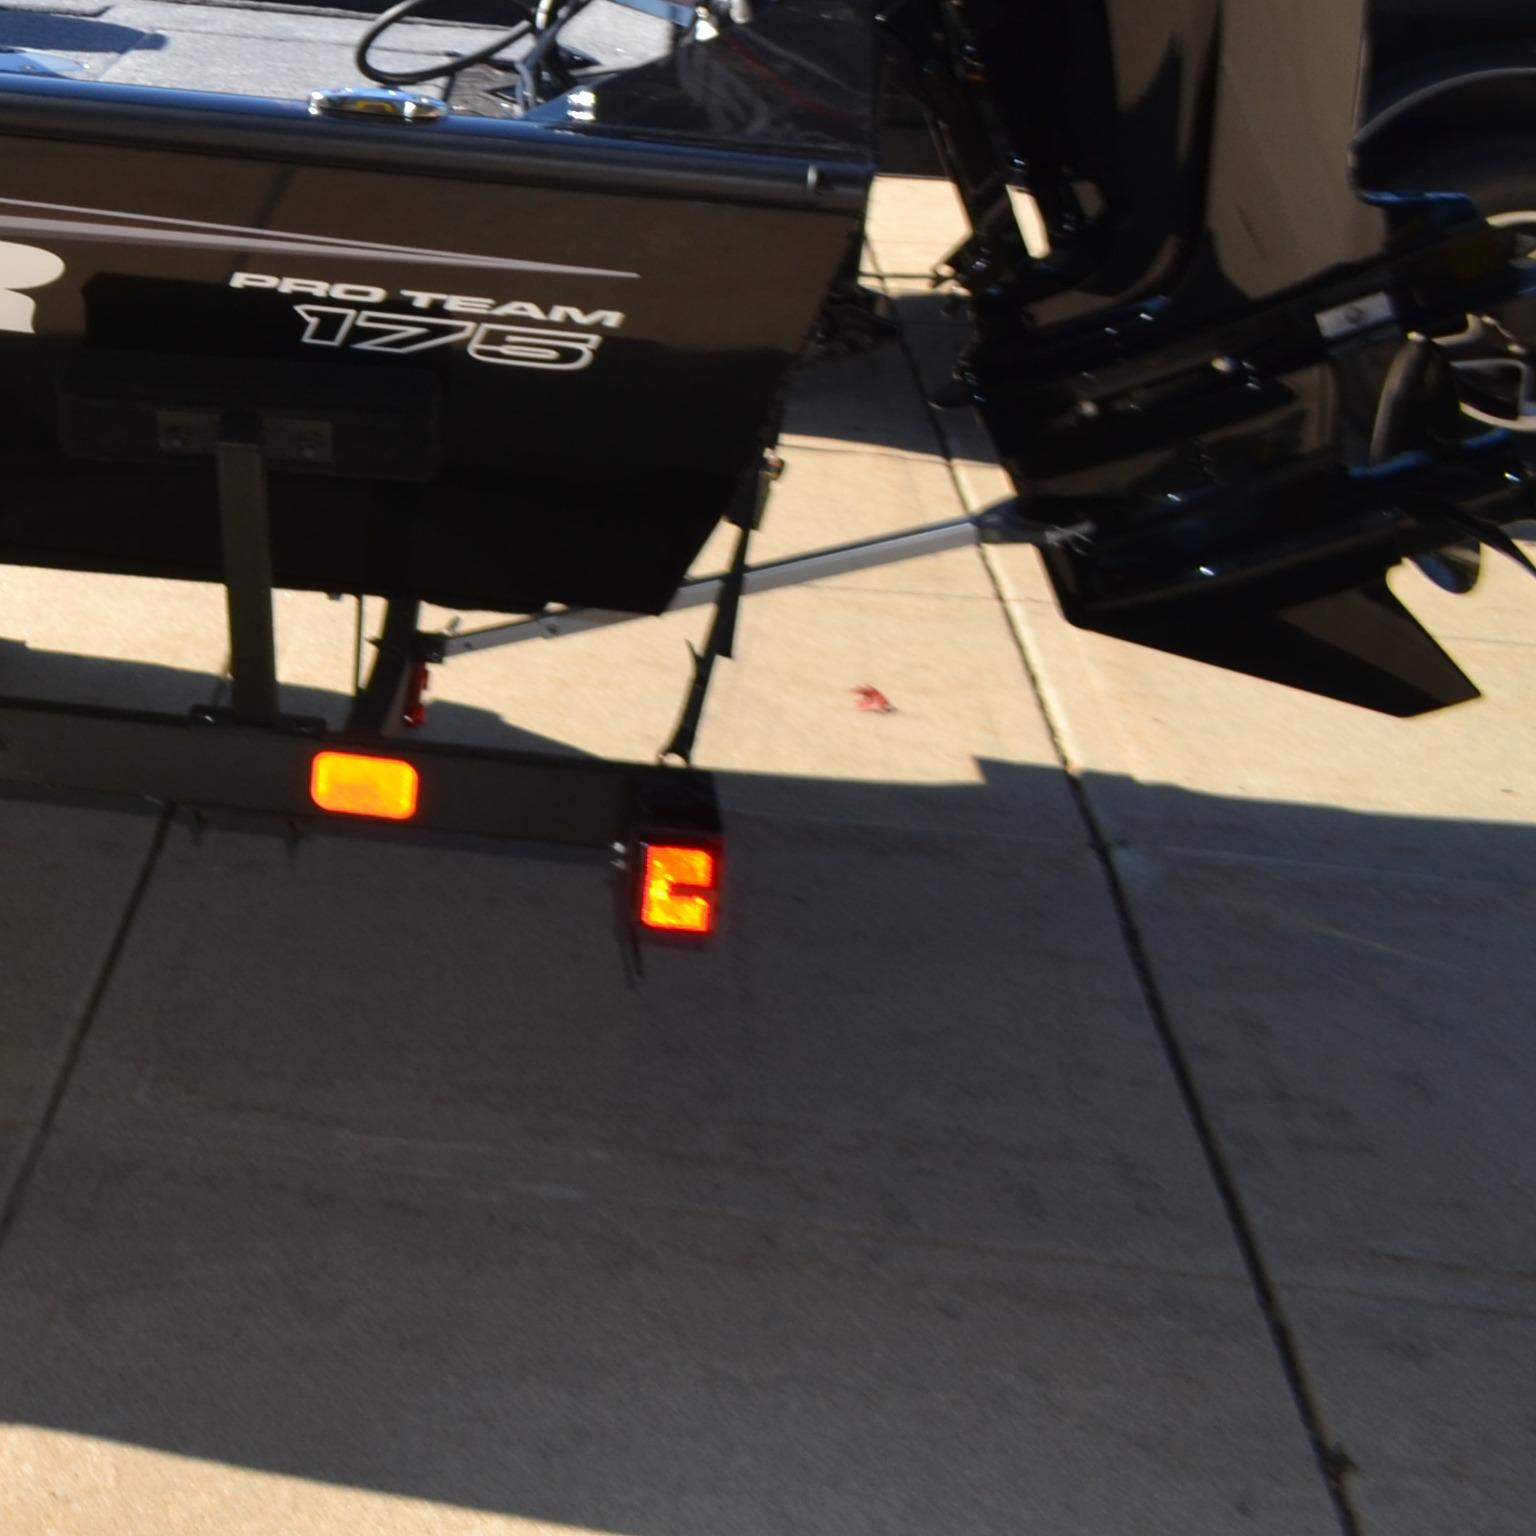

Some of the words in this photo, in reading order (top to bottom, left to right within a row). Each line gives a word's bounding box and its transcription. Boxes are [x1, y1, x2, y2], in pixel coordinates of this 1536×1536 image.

[228, 271, 387, 304] PRO
[399, 289, 627, 329] TEAM
[293, 302, 604, 371] 175
